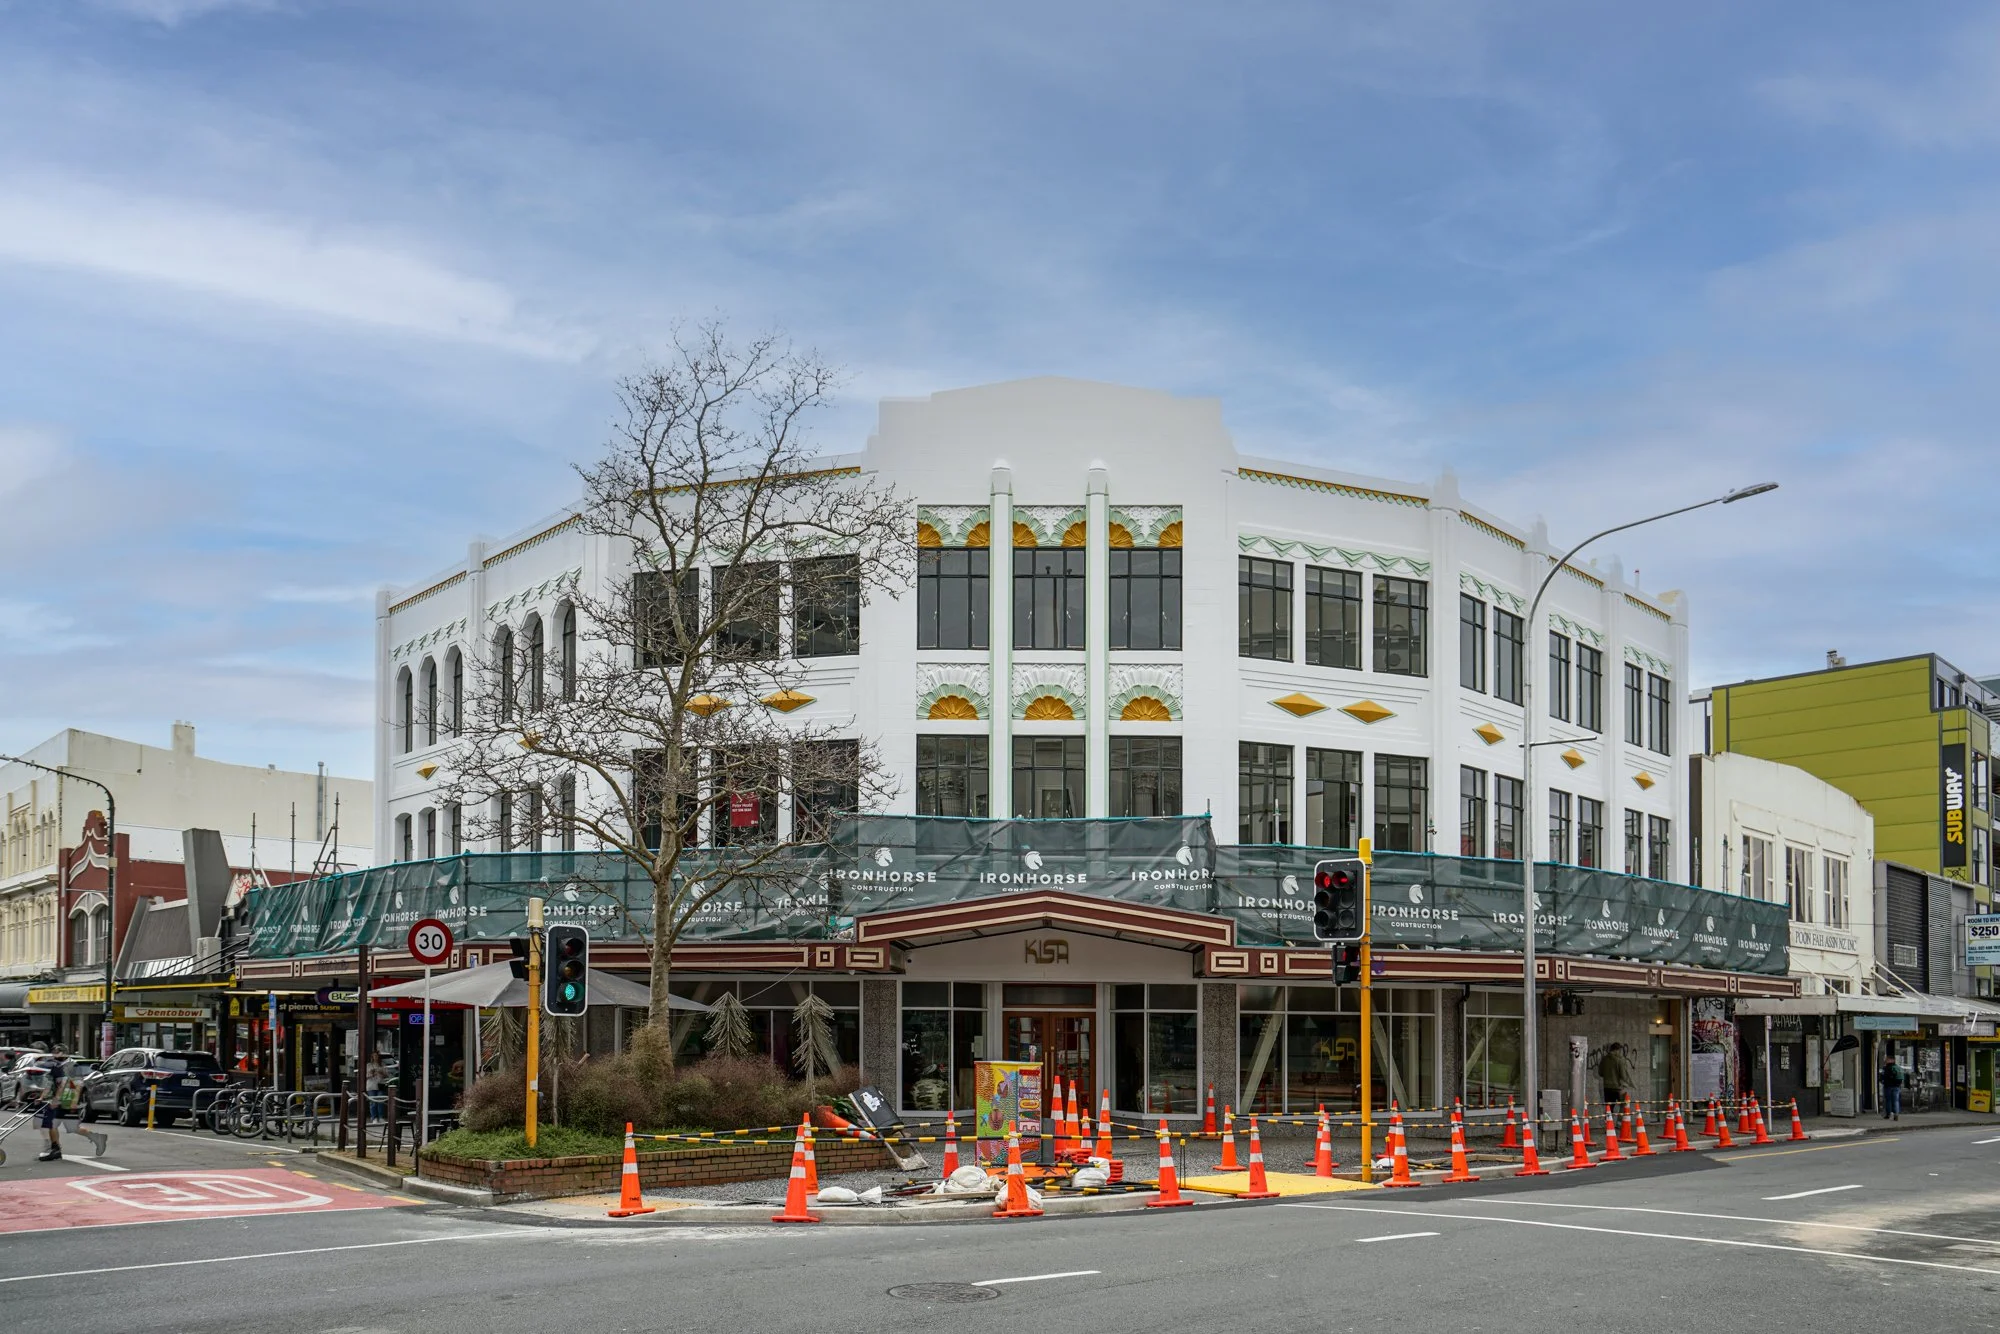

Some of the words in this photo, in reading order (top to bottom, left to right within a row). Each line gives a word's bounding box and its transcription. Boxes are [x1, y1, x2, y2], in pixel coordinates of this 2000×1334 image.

[1945, 767, 1964, 844] SUBWAY
[829, 868, 937, 883] IRONHORSE
[980, 872, 1087, 885] IRONHORSE
[851, 884, 914, 892] CONSTRUCTION
[1154, 883, 1213, 891] CONSTRUCTION
[525, 905, 616, 917] IONHORSE
[1372, 904, 1459, 921] IRONHORSE
[1390, 921, 1442, 930] CONSTRUCTION
[1971, 926, 1999, 937] $250
[419, 933, 443, 950] 30
[1796, 931, 1812, 945] POON
[1024, 939, 1069, 964] KISA
[288, 1003, 318, 1012] pierres
[1320, 1037, 1357, 1062] KISA
[122, 1180, 278, 1201] 30
